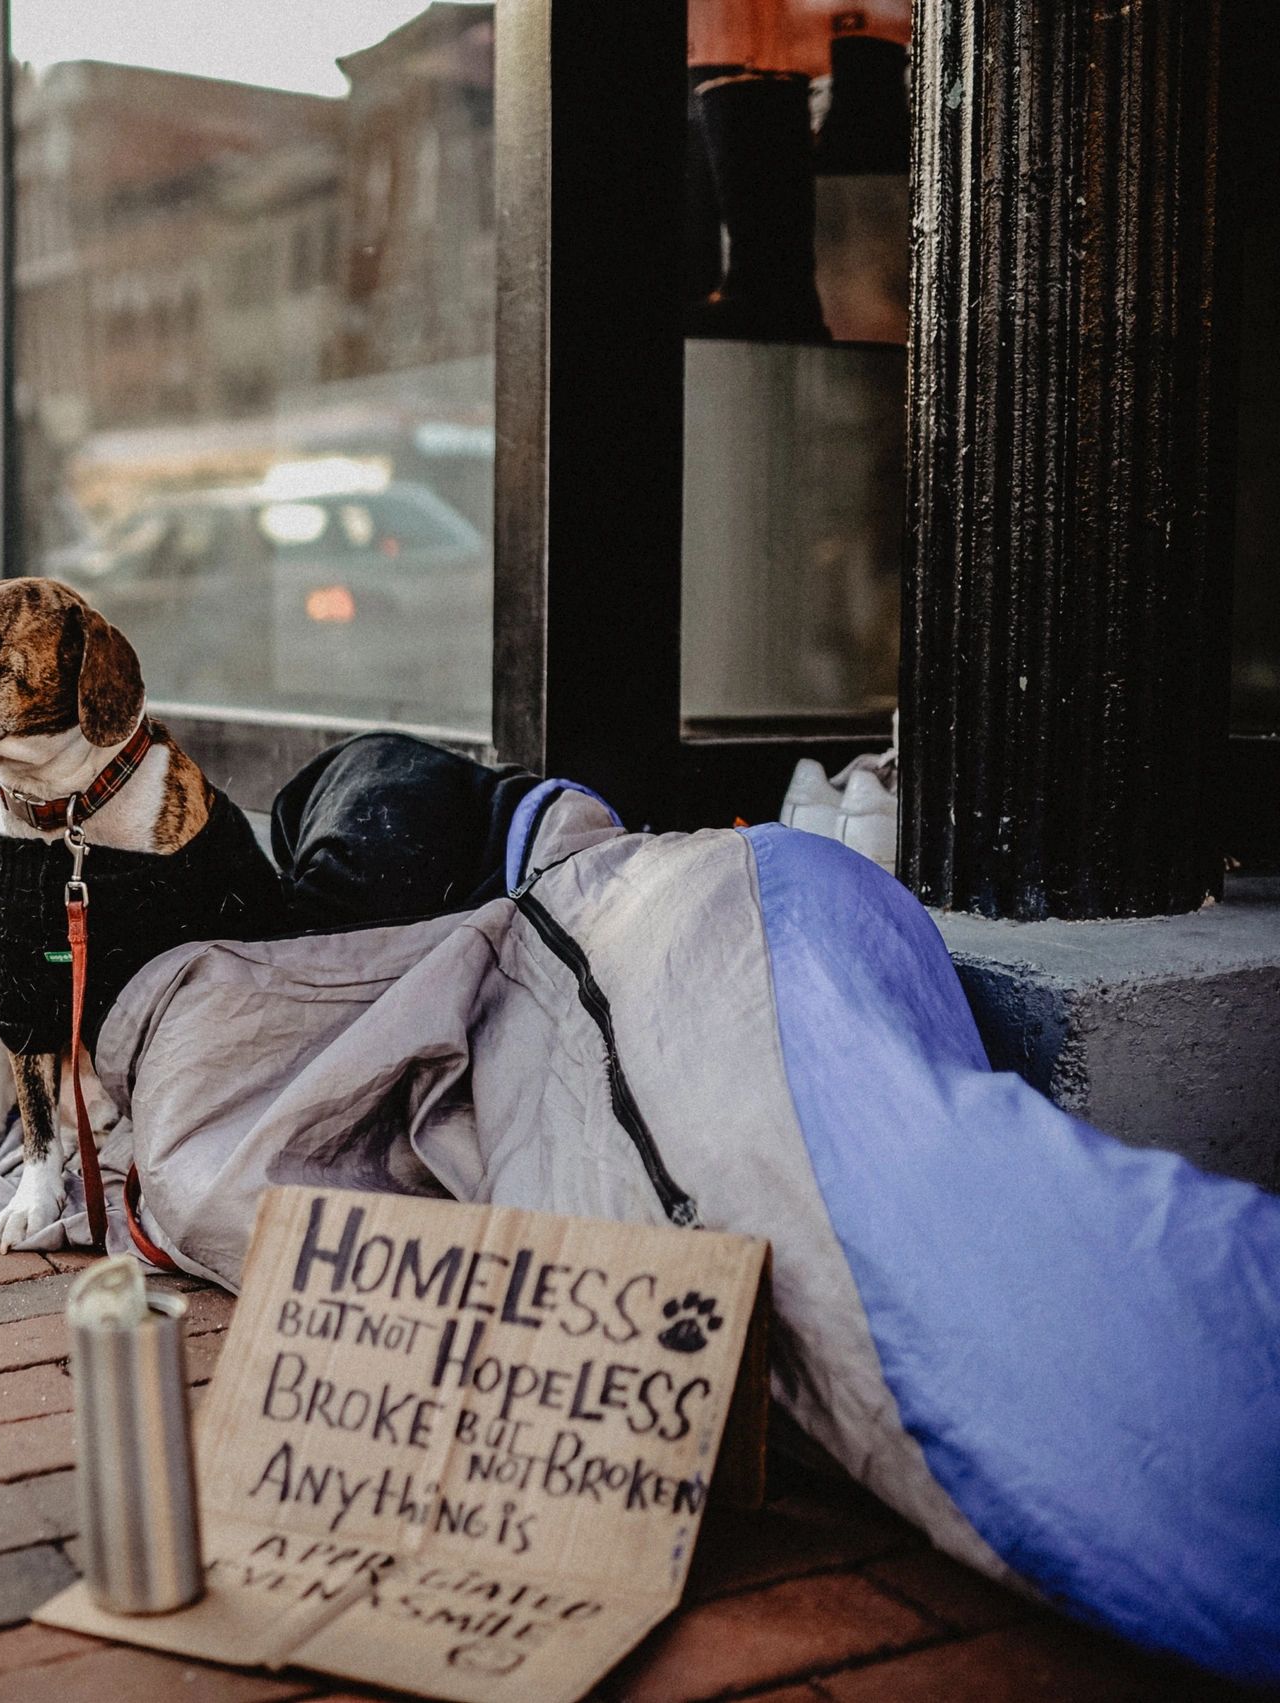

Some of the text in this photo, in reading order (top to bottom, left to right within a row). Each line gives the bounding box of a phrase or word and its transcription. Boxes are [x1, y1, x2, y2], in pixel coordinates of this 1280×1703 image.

[292, 1197, 657, 1343] HOMELESS
[356, 1313, 438, 1355] NOT
[262, 1351, 532, 1456] BROKE BUT
[468, 1431, 708, 1516] NOT BROKEN
[250, 1535, 603, 1620] APPRCIATED
